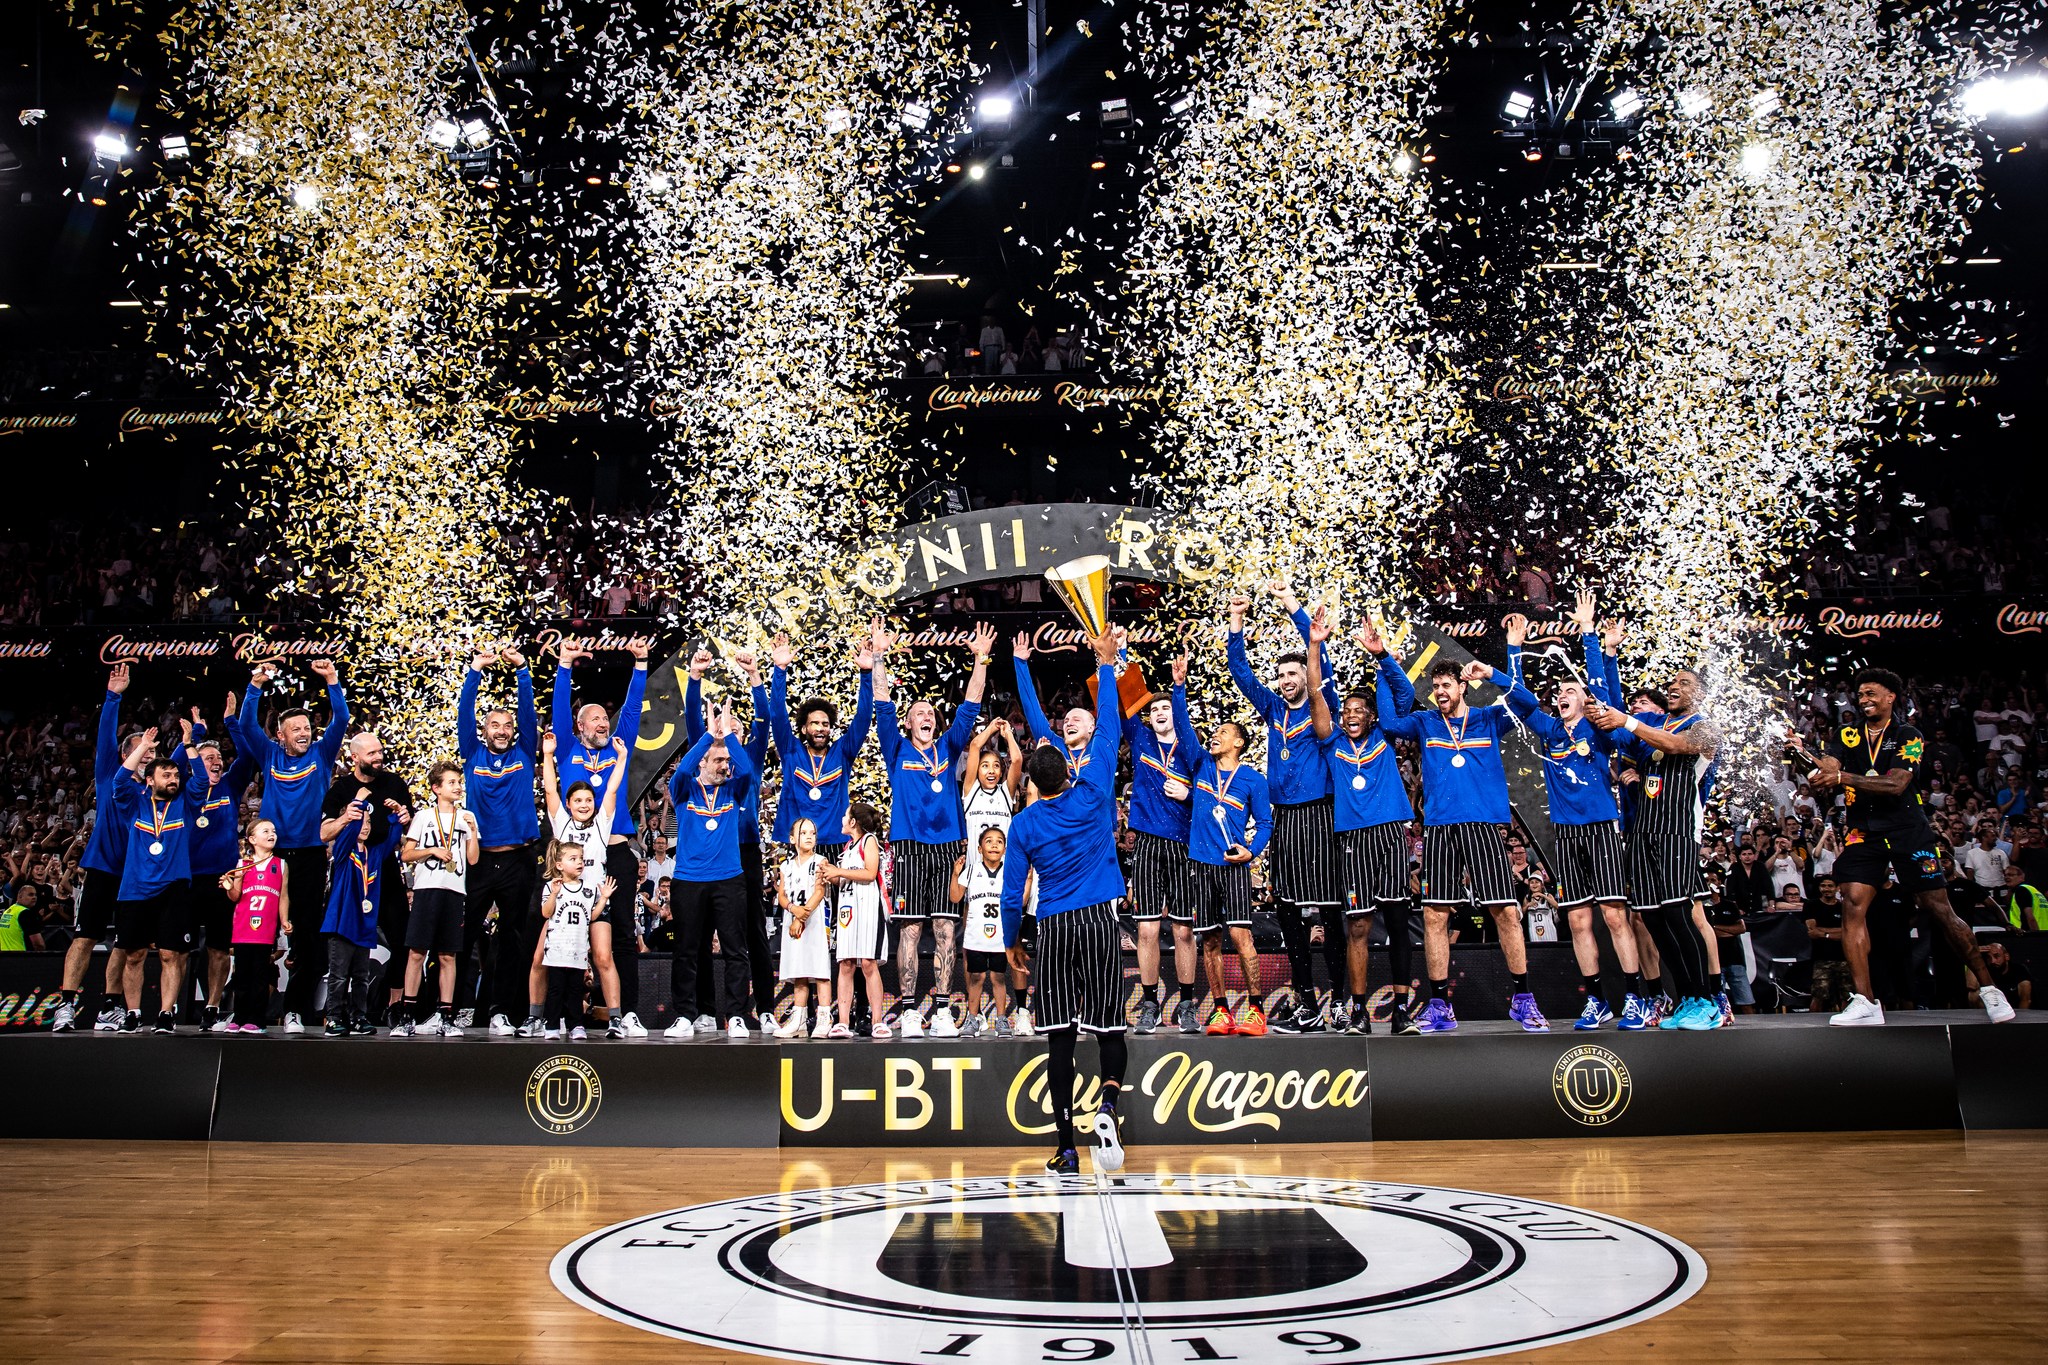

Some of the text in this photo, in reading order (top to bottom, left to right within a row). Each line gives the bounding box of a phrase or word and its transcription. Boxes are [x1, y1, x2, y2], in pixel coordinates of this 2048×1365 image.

[928, 383, 1042, 411] Campionii
[0, 412, 78, 435] omâniei
[119, 407, 223, 433] Campionii
[1819, 606, 1943, 638] României
[99, 634, 219, 665] Campionii
[249, 895, 268, 911] 27
[789, 889, 807, 907] 14
[983, 903, 1000, 919] 35
[567, 911, 580, 925] 15
[840, 910, 851, 919] BT
[1533, 913, 1543, 923] 10
[533, 1057, 592, 1080] UNIVERSITATEA
[590, 1077, 600, 1098] CLUJ
[1558, 1047, 1618, 1071] UNIVERSITATEA
[1617, 1066, 1630, 1088] CLUJ
[546, 1077, 582, 1117] U
[779, 1057, 982, 1132] U-BT
[1573, 1067, 1611, 1108] U
[549, 1123, 574, 1132] 1919
[1583, 1114, 1608, 1123] 1919
[747, 1177, 1428, 1213] UNIVERSITATEA
[1448, 1201, 1622, 1243] CLUJ
[875, 1207, 1369, 1302] U
[920, 1329, 1362, 1362] 1919
